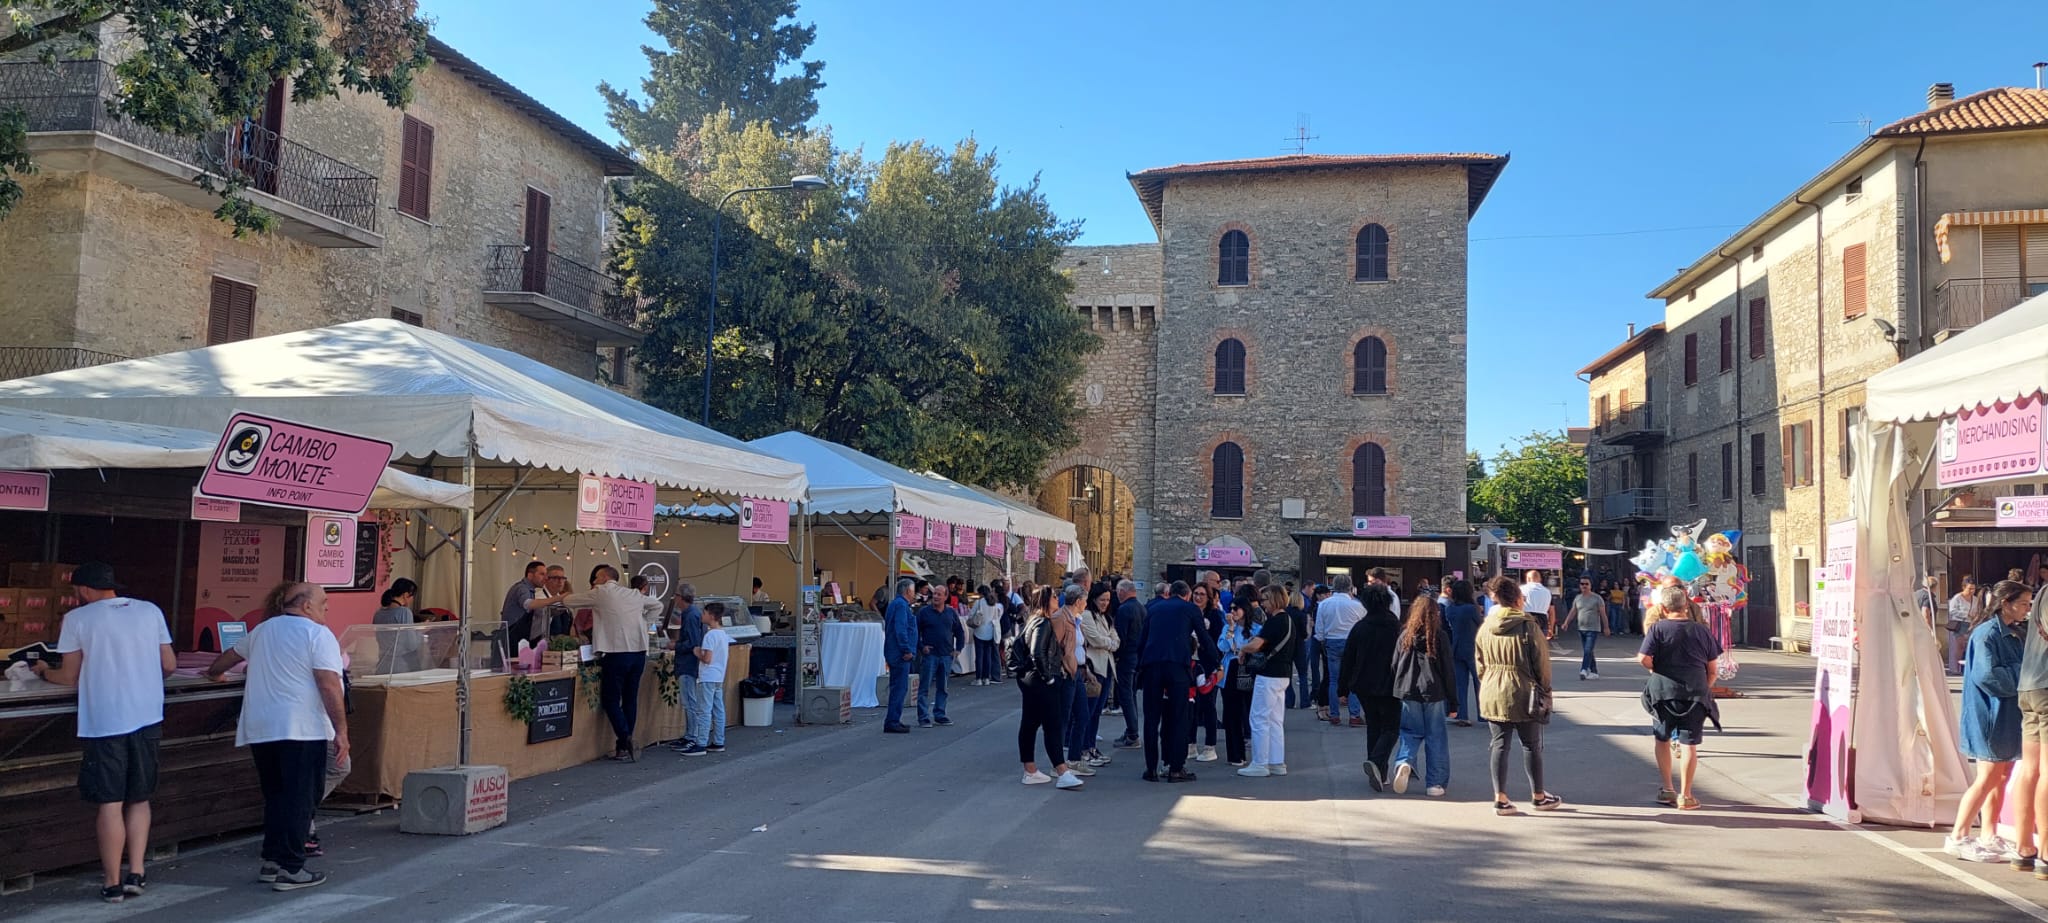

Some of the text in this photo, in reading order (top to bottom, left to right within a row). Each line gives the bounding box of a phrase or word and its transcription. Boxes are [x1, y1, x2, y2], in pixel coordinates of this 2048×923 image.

[1959, 415, 2037, 445] MERCHANDISING
[271, 432, 337, 461] CAMBIO
[258, 456, 332, 486] MONETE
[266, 487, 313, 501] INFO POINT
[602, 482, 645, 501] PORCHETTA
[602, 501, 638, 517] DI GRUTTI
[223, 556, 260, 564] MAGGIO 2024
[319, 549, 345, 558] CAMBIO
[317, 559, 345, 568] MONETE
[473, 774, 506, 796] MUSCI
